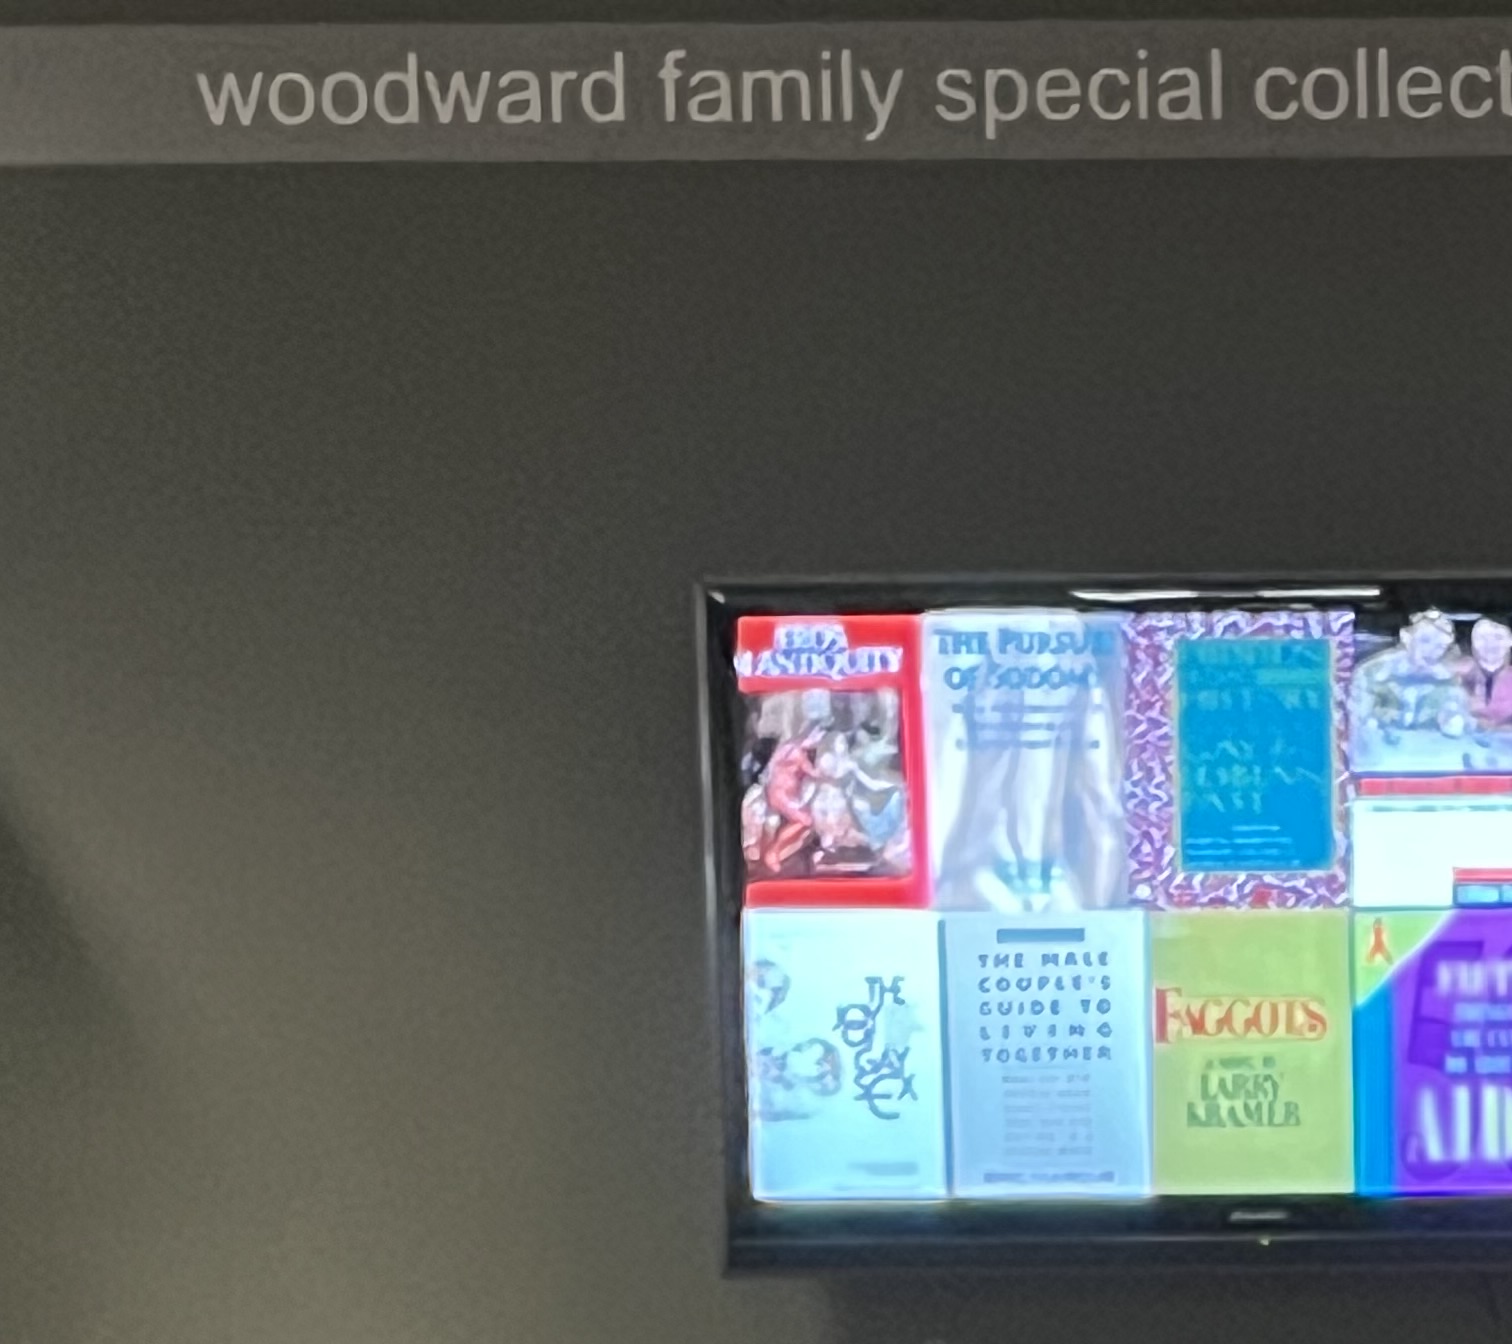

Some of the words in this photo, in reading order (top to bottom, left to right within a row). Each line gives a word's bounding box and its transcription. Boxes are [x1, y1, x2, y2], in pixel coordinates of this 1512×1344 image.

[196, 50, 625, 127] woodward
[658, 47, 904, 142] family
[934, 46, 1223, 140] special
[977, 952, 1024, 968] THE
[1041, 951, 1109, 967] MALE
[979, 998, 1060, 1016] GUIDE
[1080, 998, 1111, 1015] TO
[1155, 986, 1328, 1045] FAGGOTS
[979, 1021, 1113, 1041] LIVING
[981, 1045, 1112, 1063] TOGETHER
